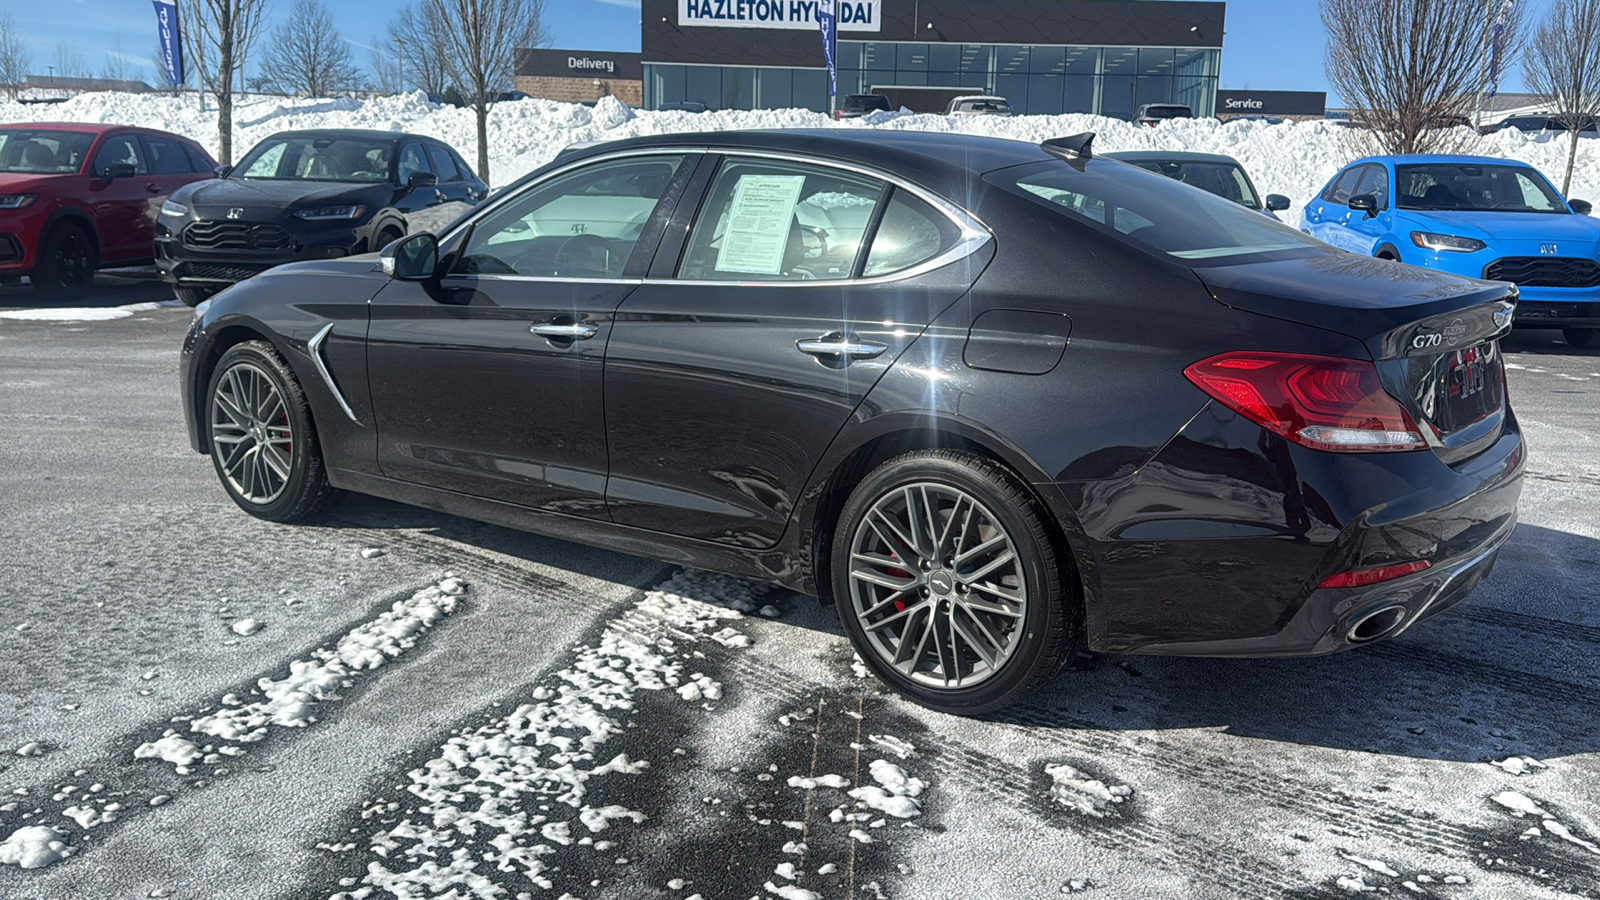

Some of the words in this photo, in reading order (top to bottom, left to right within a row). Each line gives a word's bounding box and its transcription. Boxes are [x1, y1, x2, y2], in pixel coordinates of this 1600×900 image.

[687, 0, 784, 21] HAZLETON
[789, 0, 872, 24] HYUDAI
[567, 56, 615, 72] Delivery
[1225, 98, 1263, 109] Service
[1413, 333, 1442, 349] G70
